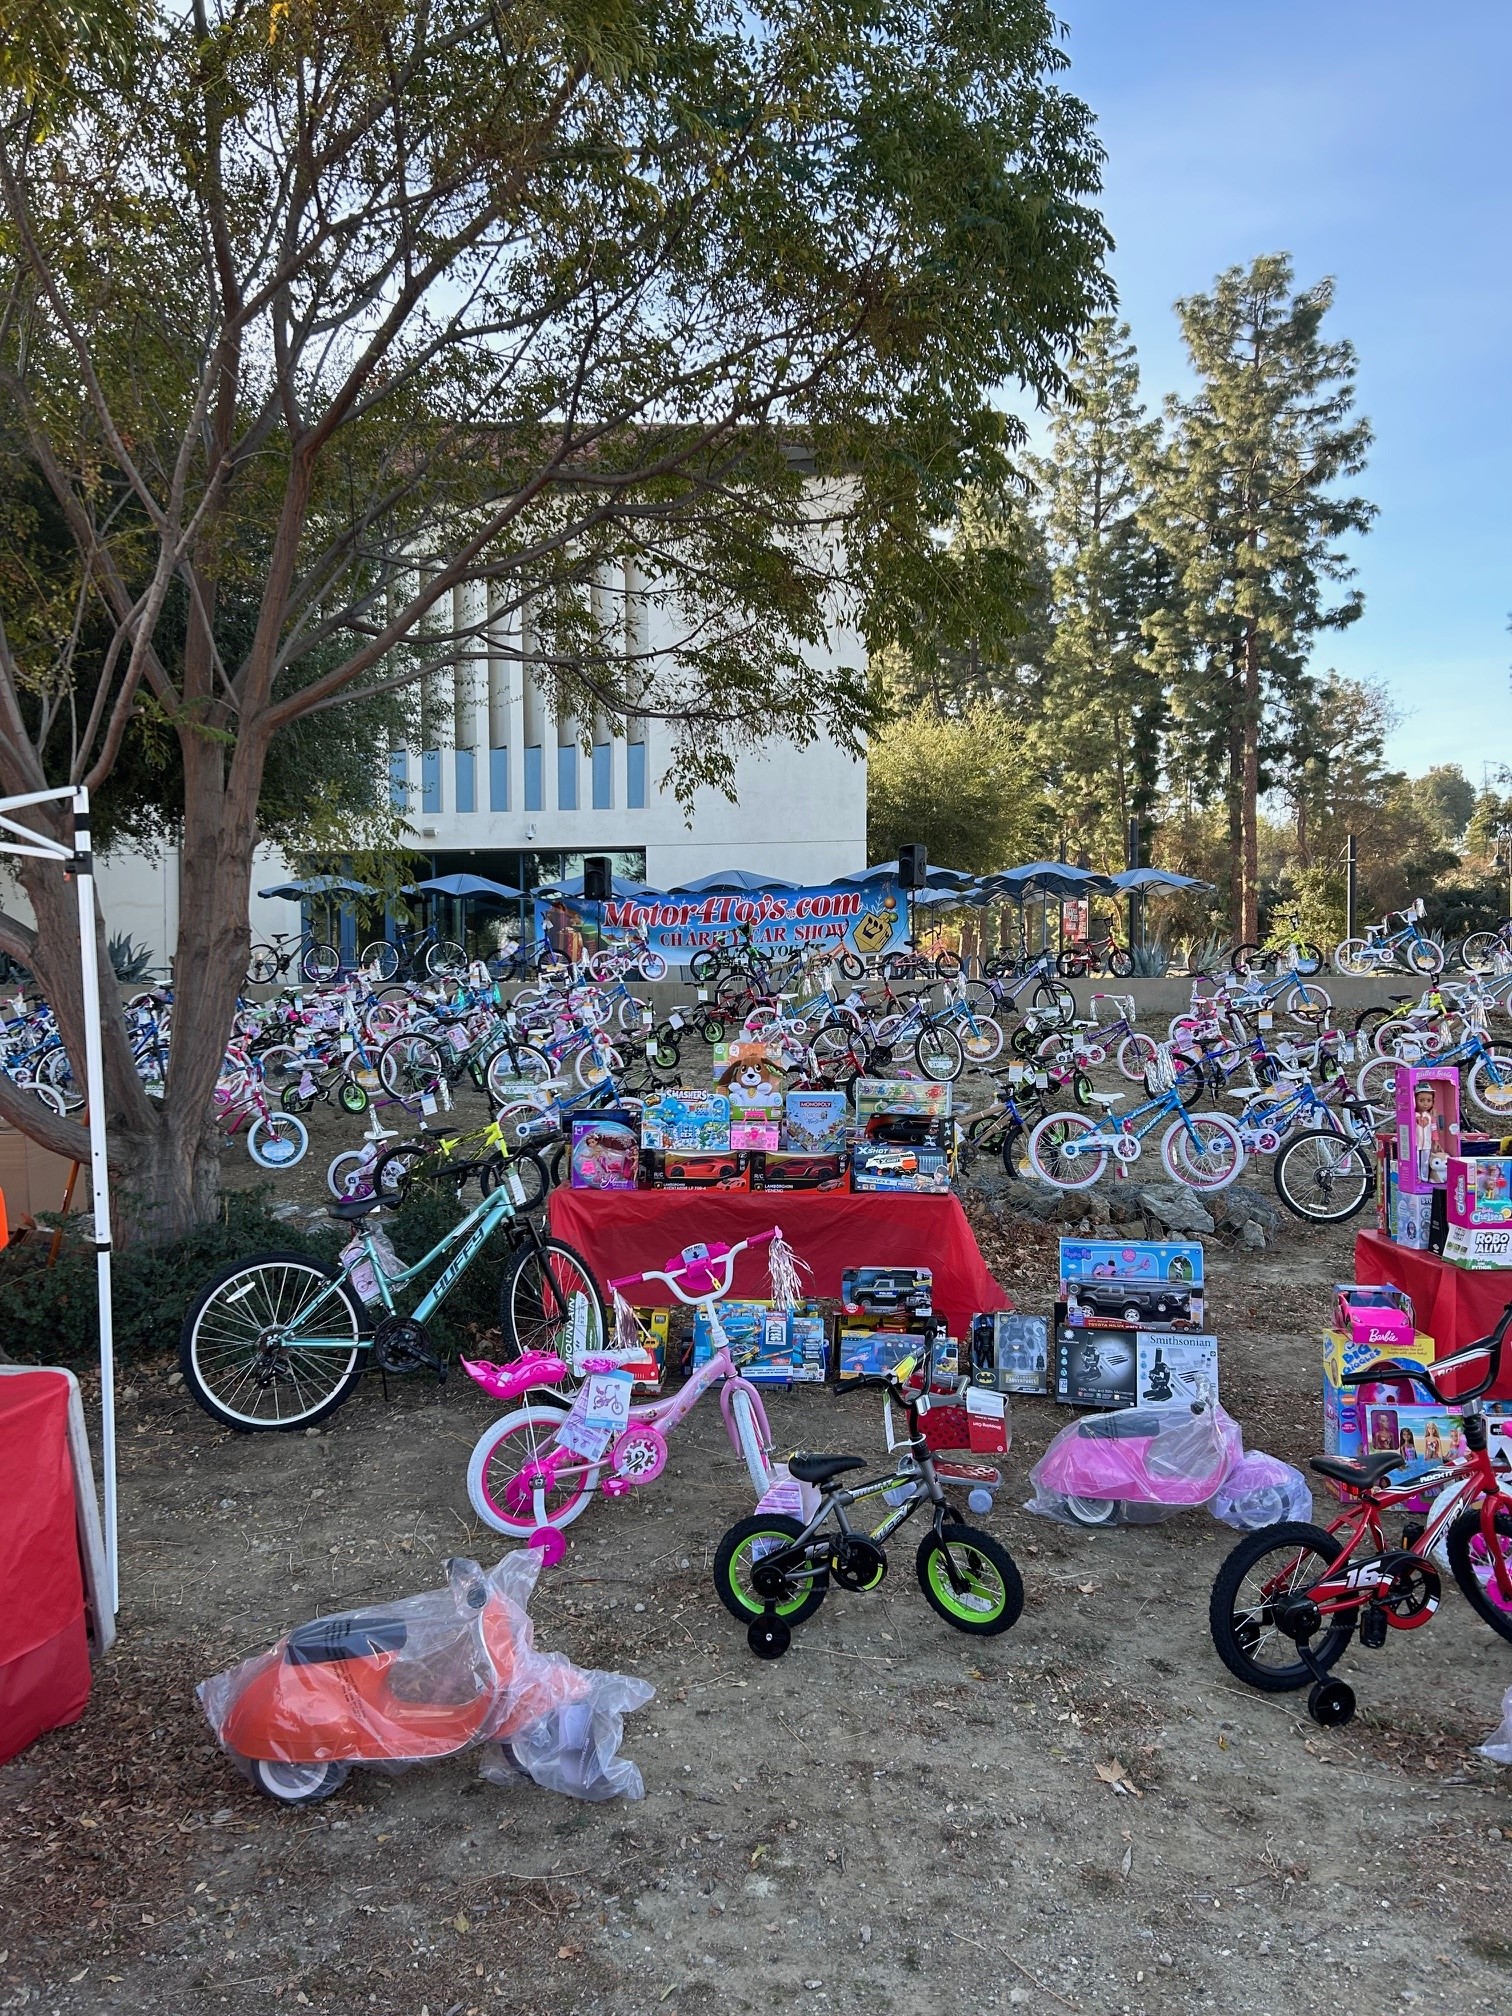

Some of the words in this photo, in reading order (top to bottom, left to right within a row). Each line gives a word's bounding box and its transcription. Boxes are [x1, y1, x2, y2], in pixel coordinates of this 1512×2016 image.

[602, 892, 861, 929] Motor4Toys.com
[660, 926, 740, 947] CHARITY
[750, 926, 787, 944] CAR
[794, 922, 848, 942] SHOW
[666, 1089, 707, 1101] SMASHERS
[1472, 1211, 1503, 1222] Chelsea
[1475, 1231, 1510, 1244] ROBO
[1475, 1243, 1508, 1254] ALIVE
[432, 1226, 484, 1300] HUFFY
[565, 1298, 575, 1365] MOUNTAIN
[1369, 1328, 1398, 1342] Barbie
[1150, 1335, 1211, 1347] Smithsonian
[1342, 1344, 1371, 1364] BIG
[1343, 1348, 1381, 1375] GIGGLES
[804, 1542, 830, 1559] 12
[1346, 1561, 1381, 1589] 16
